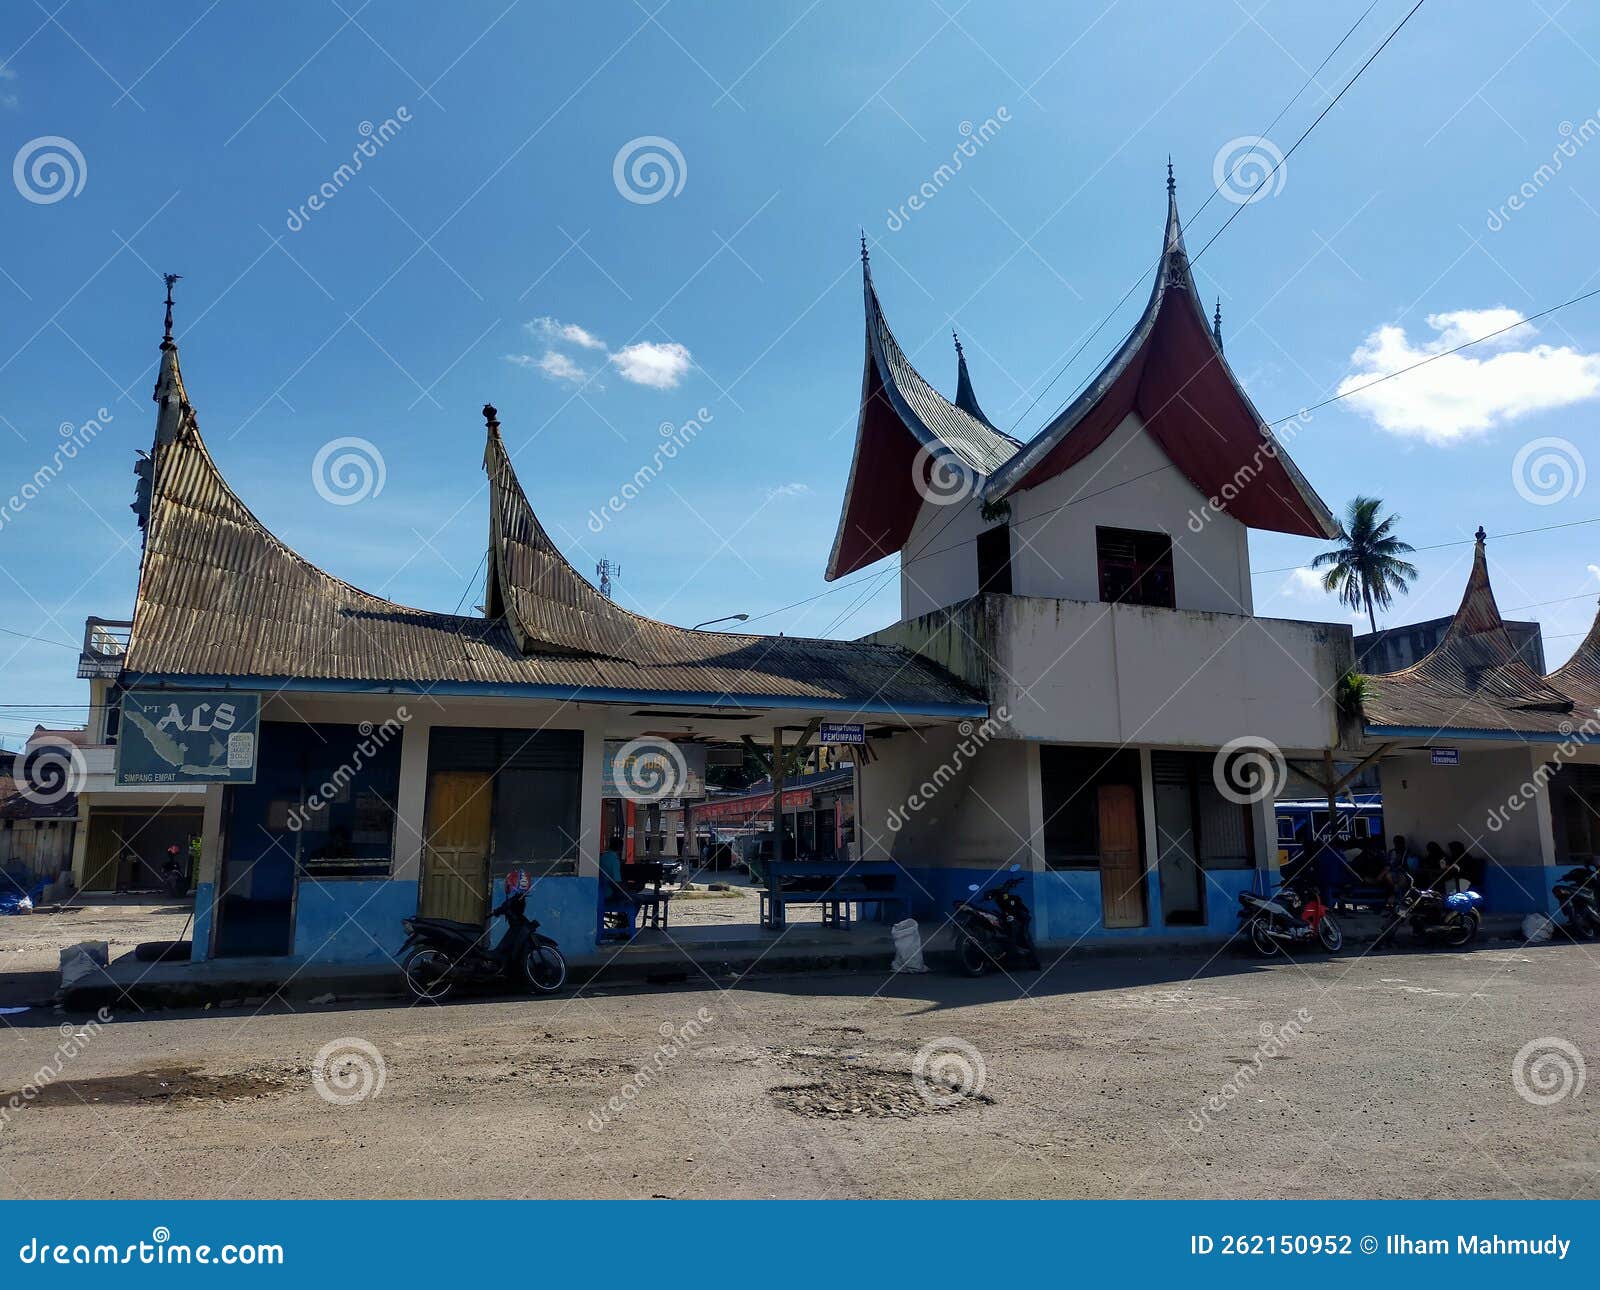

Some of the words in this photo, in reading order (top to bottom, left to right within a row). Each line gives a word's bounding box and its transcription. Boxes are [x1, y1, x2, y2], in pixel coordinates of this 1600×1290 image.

[143, 705, 161, 713] PT
[124, 773, 153, 783] SIMPANG
[154, 773, 177, 782] EMPAT
